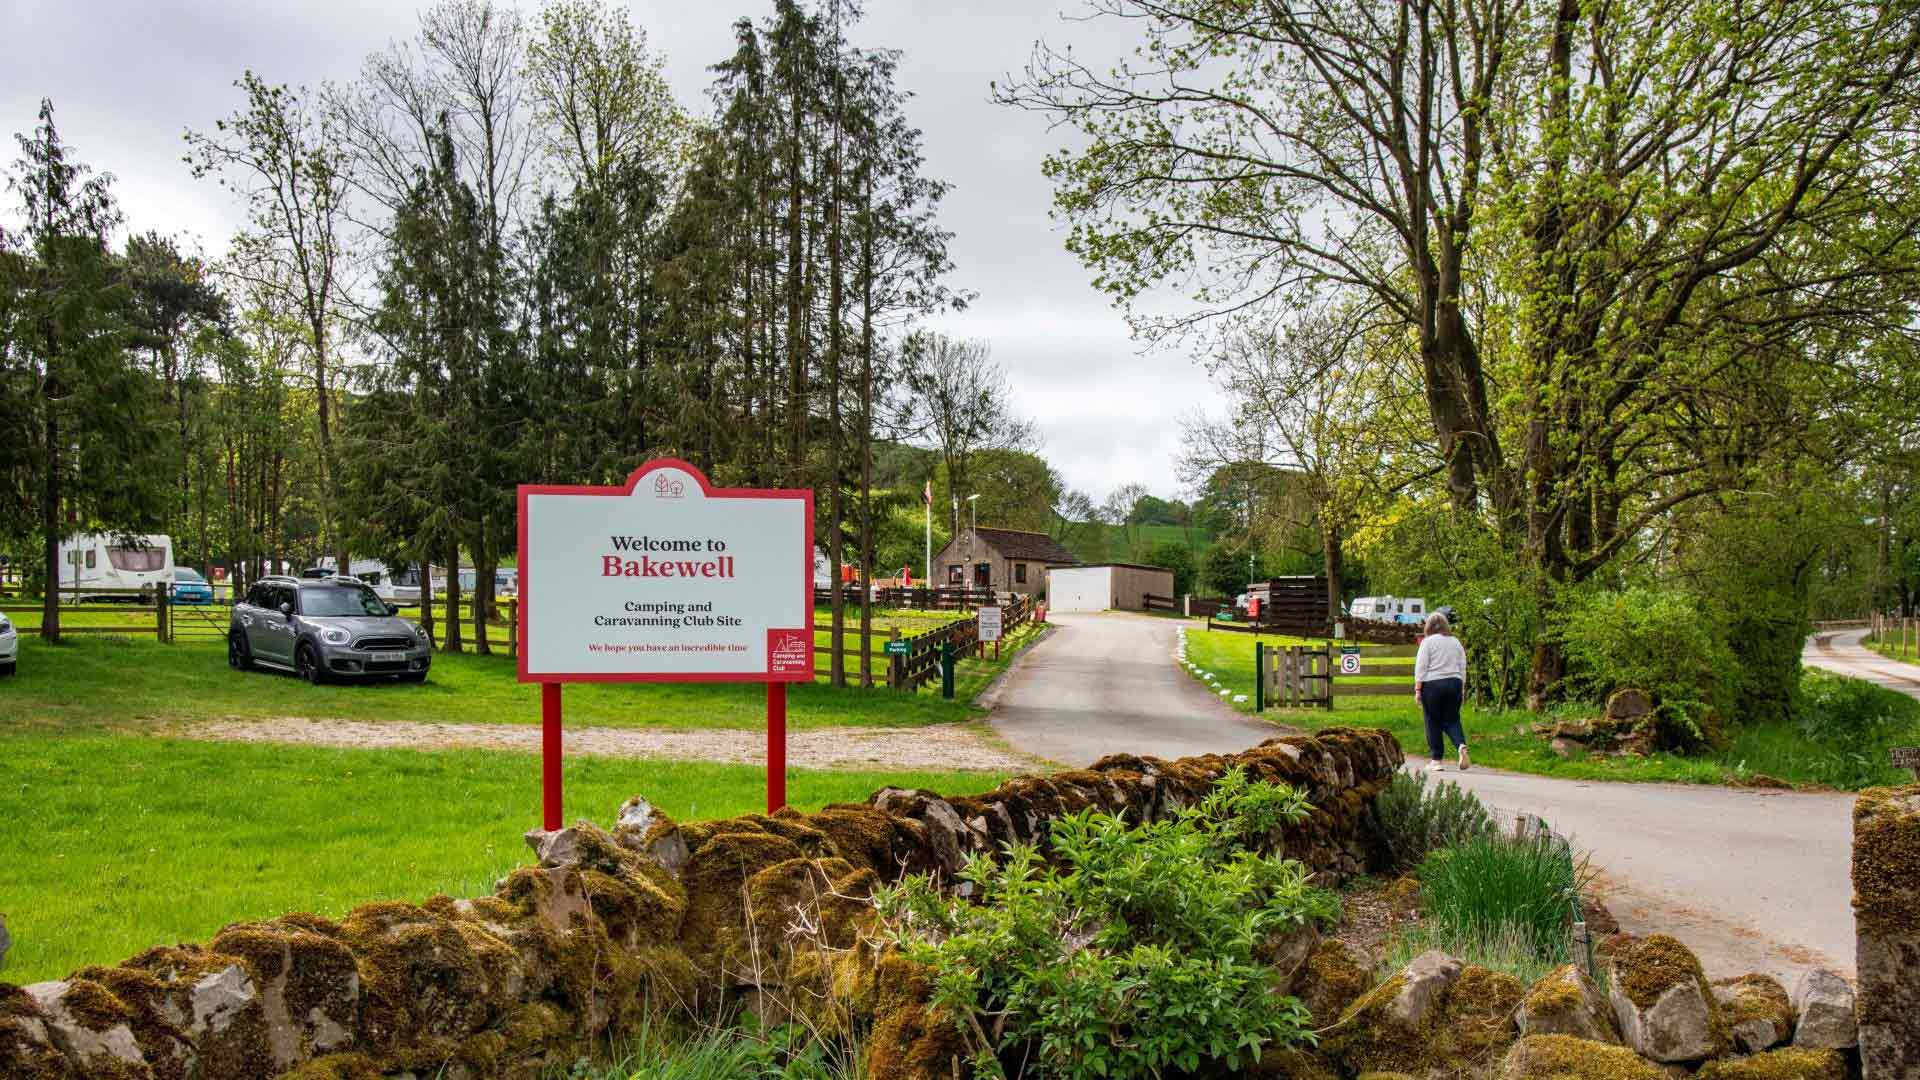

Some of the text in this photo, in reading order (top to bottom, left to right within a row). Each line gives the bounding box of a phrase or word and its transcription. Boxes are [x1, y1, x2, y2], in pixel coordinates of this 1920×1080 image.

[611, 536, 726, 552] Welcome to
[601, 555, 735, 578] Bakewell
[624, 601, 712, 614] Camping and
[594, 615, 743, 628] Caravanning Club Site
[588, 644, 603, 652] We
[605, 644, 626, 653] hope
[628, 645, 645, 653] you
[646, 644, 668, 652] have
[681, 643, 726, 652] incredible
[728, 644, 748, 652] time
[772, 652, 795, 660] Camping
[1346, 658, 1354, 669] 5
